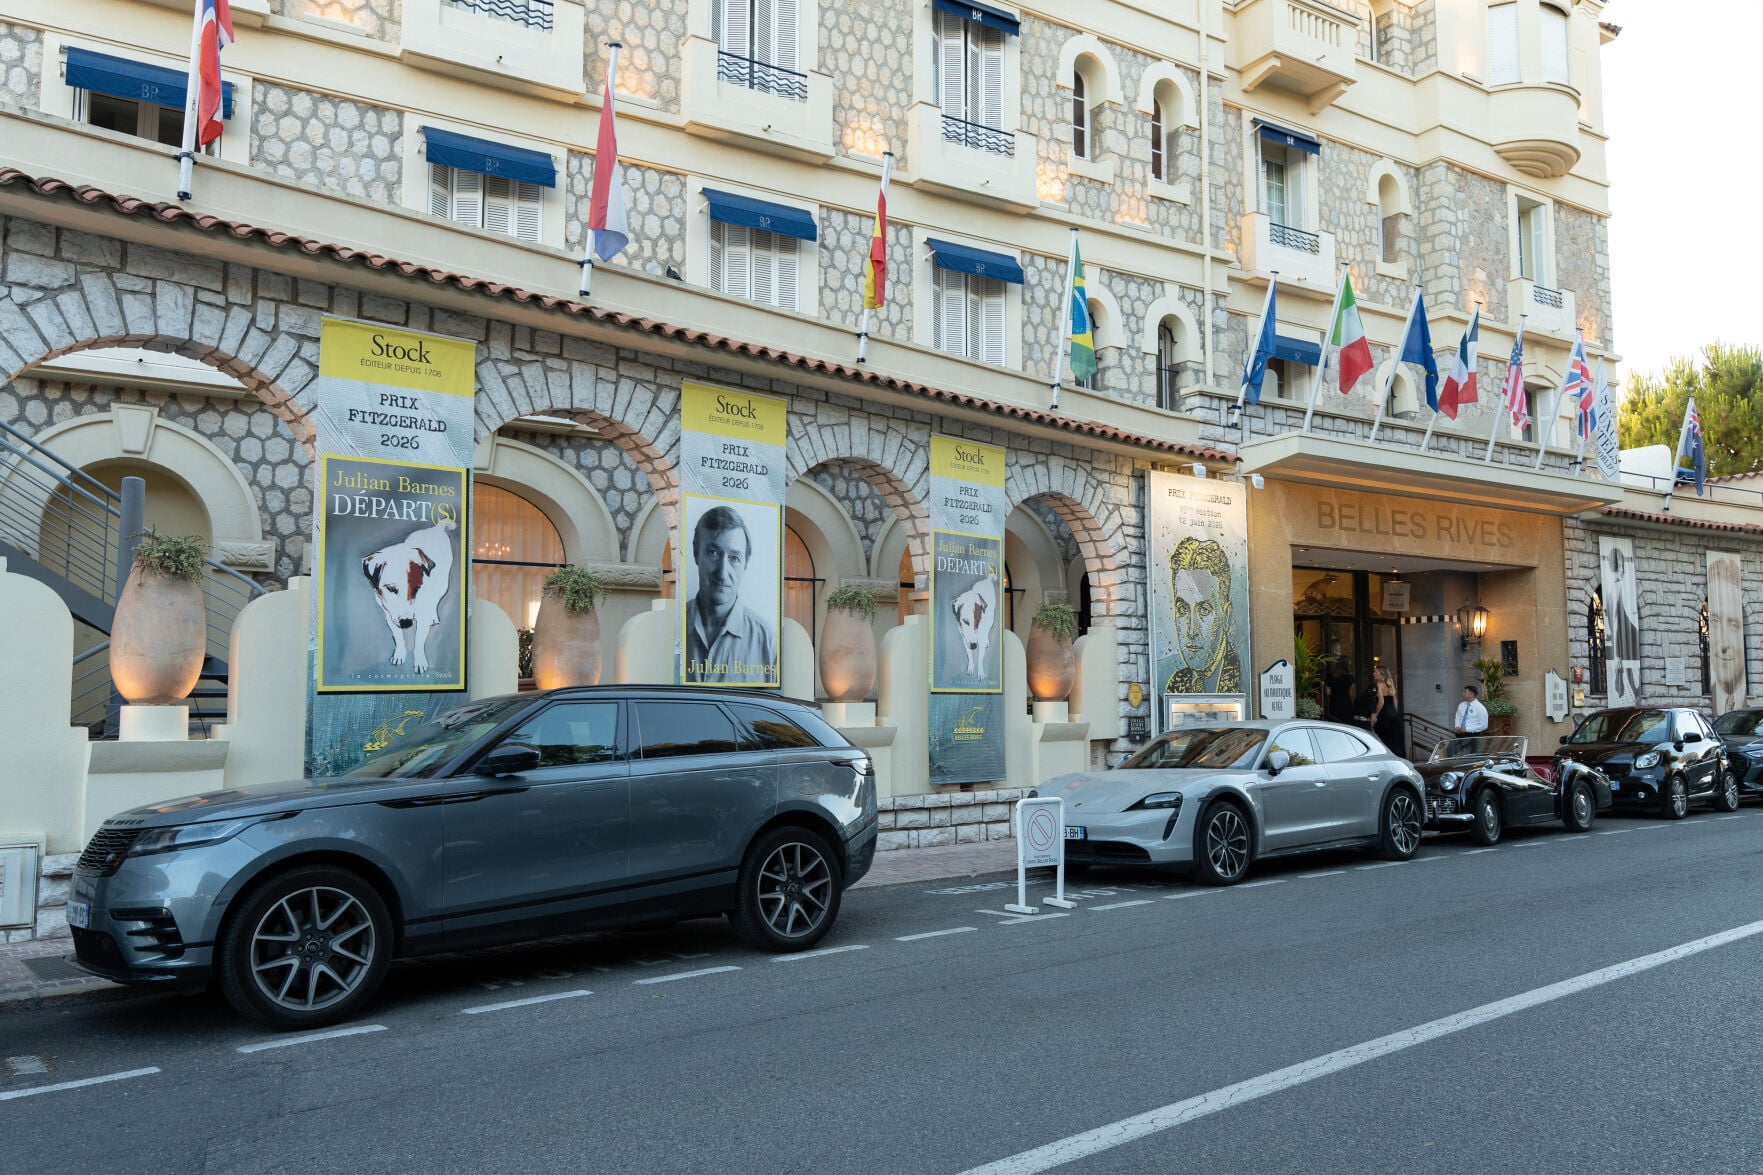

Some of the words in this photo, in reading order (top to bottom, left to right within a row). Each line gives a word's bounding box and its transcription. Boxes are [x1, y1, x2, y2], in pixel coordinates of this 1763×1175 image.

[972, 8, 982, 21] BR
[371, 334, 433, 364] Stock
[394, 363, 422, 375] DEPUIS
[424, 368, 442, 378] 1708
[379, 393, 419, 410] PRIX
[715, 394, 758, 419] Stock
[348, 408, 447, 433] FITZGERALD
[380, 434, 420, 450] 2026
[722, 443, 749, 457] PRIX
[954, 444, 985, 465] Stock
[700, 456, 768, 476] FITZGERALD
[334, 470, 390, 491] Julian
[398, 476, 456, 497] Barnes
[722, 476, 749, 490] 2026
[959, 486, 979, 498] PRIX
[1168, 488, 1186, 499] PRIX
[1189, 491, 1232, 505] FGERALD
[332, 490, 457, 527] DÉPART(S)
[944, 497, 993, 513] FITZGERALD
[959, 514, 980, 526] 2026
[1189, 517, 1205, 527] juin
[1316, 500, 1428, 540] BELLES
[1436, 514, 1515, 549] RIVES
[937, 539, 965, 554] Julian
[968, 543, 997, 558] Barnes
[937, 553, 998, 577] DÉPART(S)
[687, 659, 729, 674] Julian
[733, 660, 776, 675] Barnes
